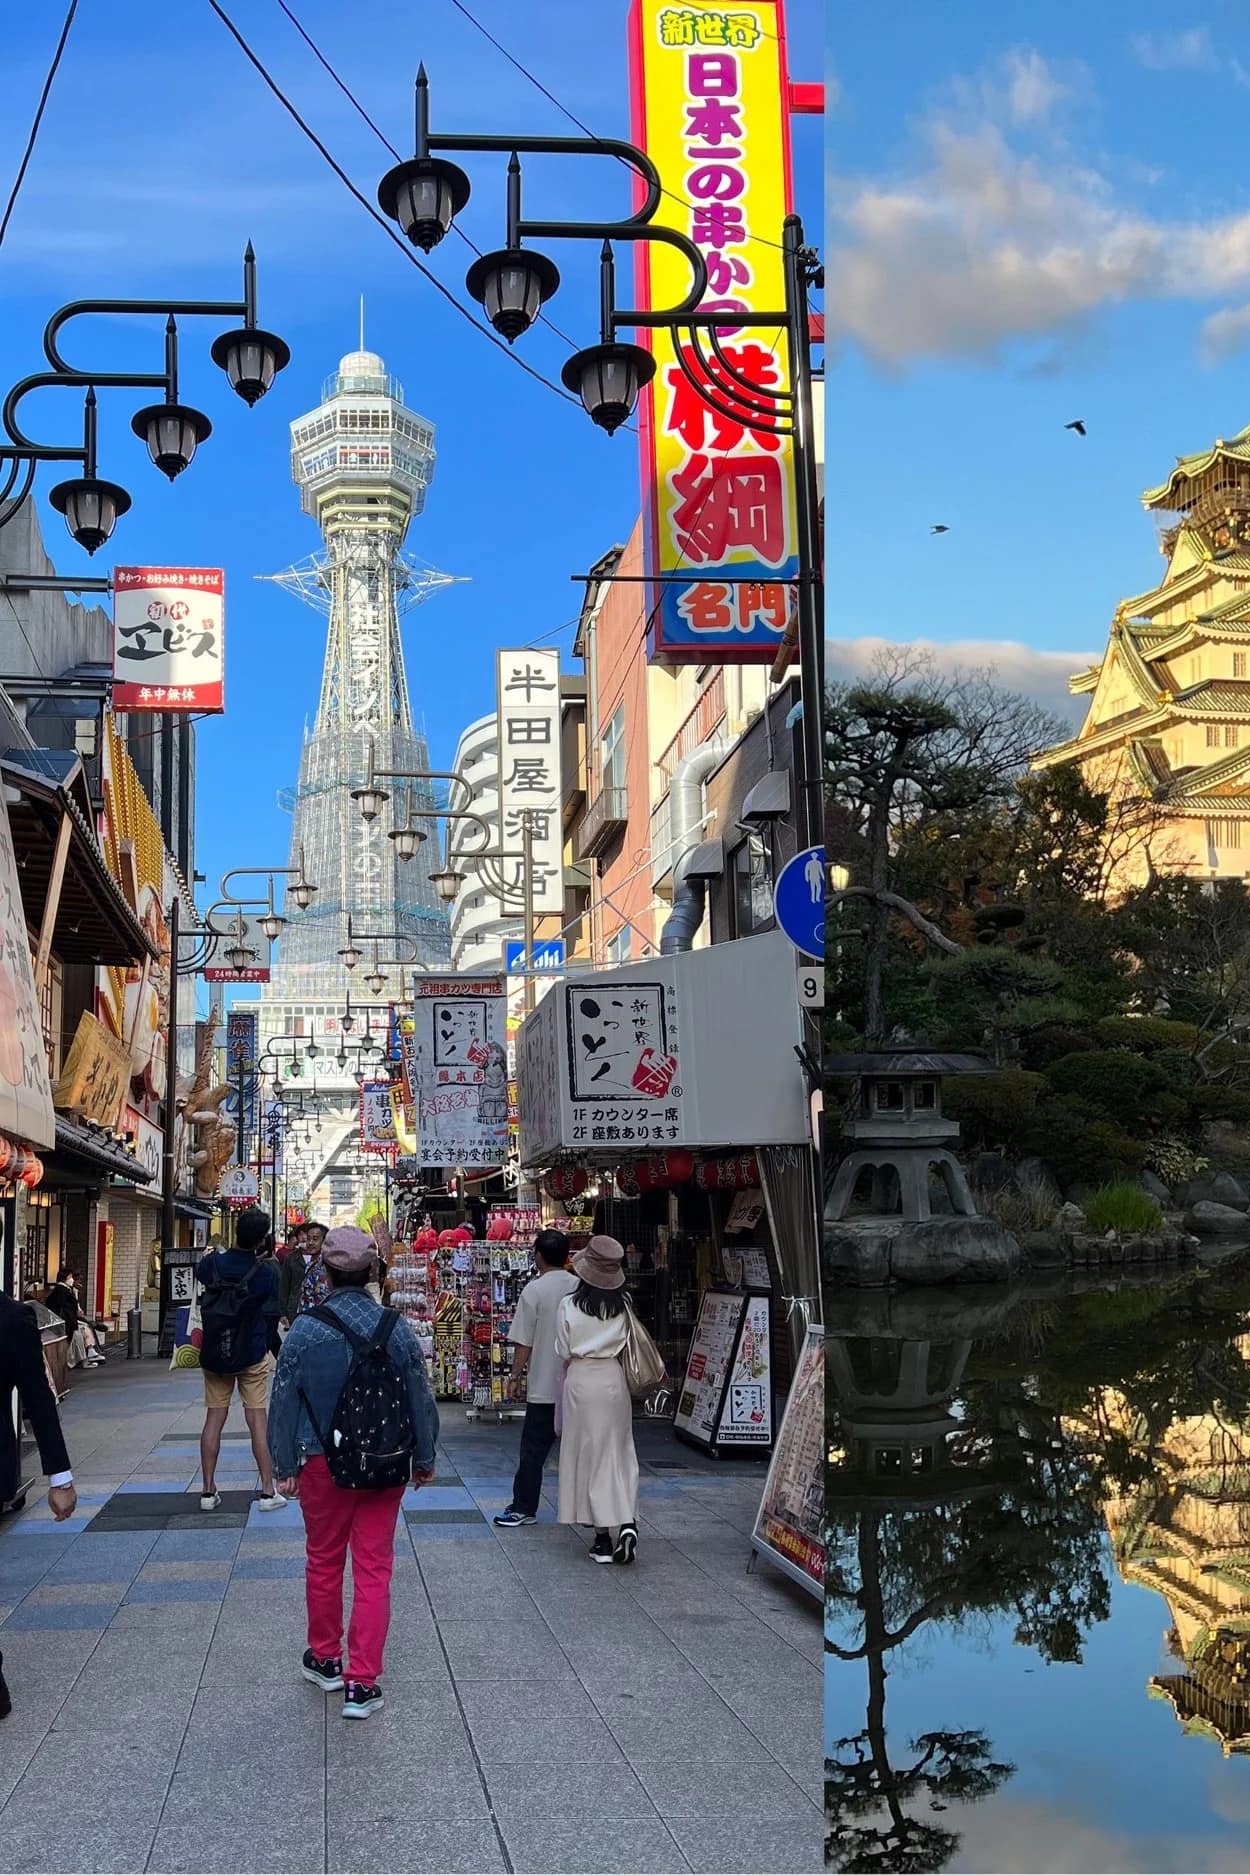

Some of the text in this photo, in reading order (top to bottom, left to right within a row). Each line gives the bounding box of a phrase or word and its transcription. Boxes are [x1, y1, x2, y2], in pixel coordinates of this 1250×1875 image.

[661, 11, 759, 47] 新世界
[681, 583, 787, 629] 名門
[139, 687, 196, 701] 年中無休
[504, 664, 557, 895] 半田屋酒店
[511, 948, 560, 969] Aahi
[419, 983, 502, 995] 元祖串カツ専門店
[803, 977, 817, 998] 9
[421, 1148, 504, 1161] 宴会予約受付中
